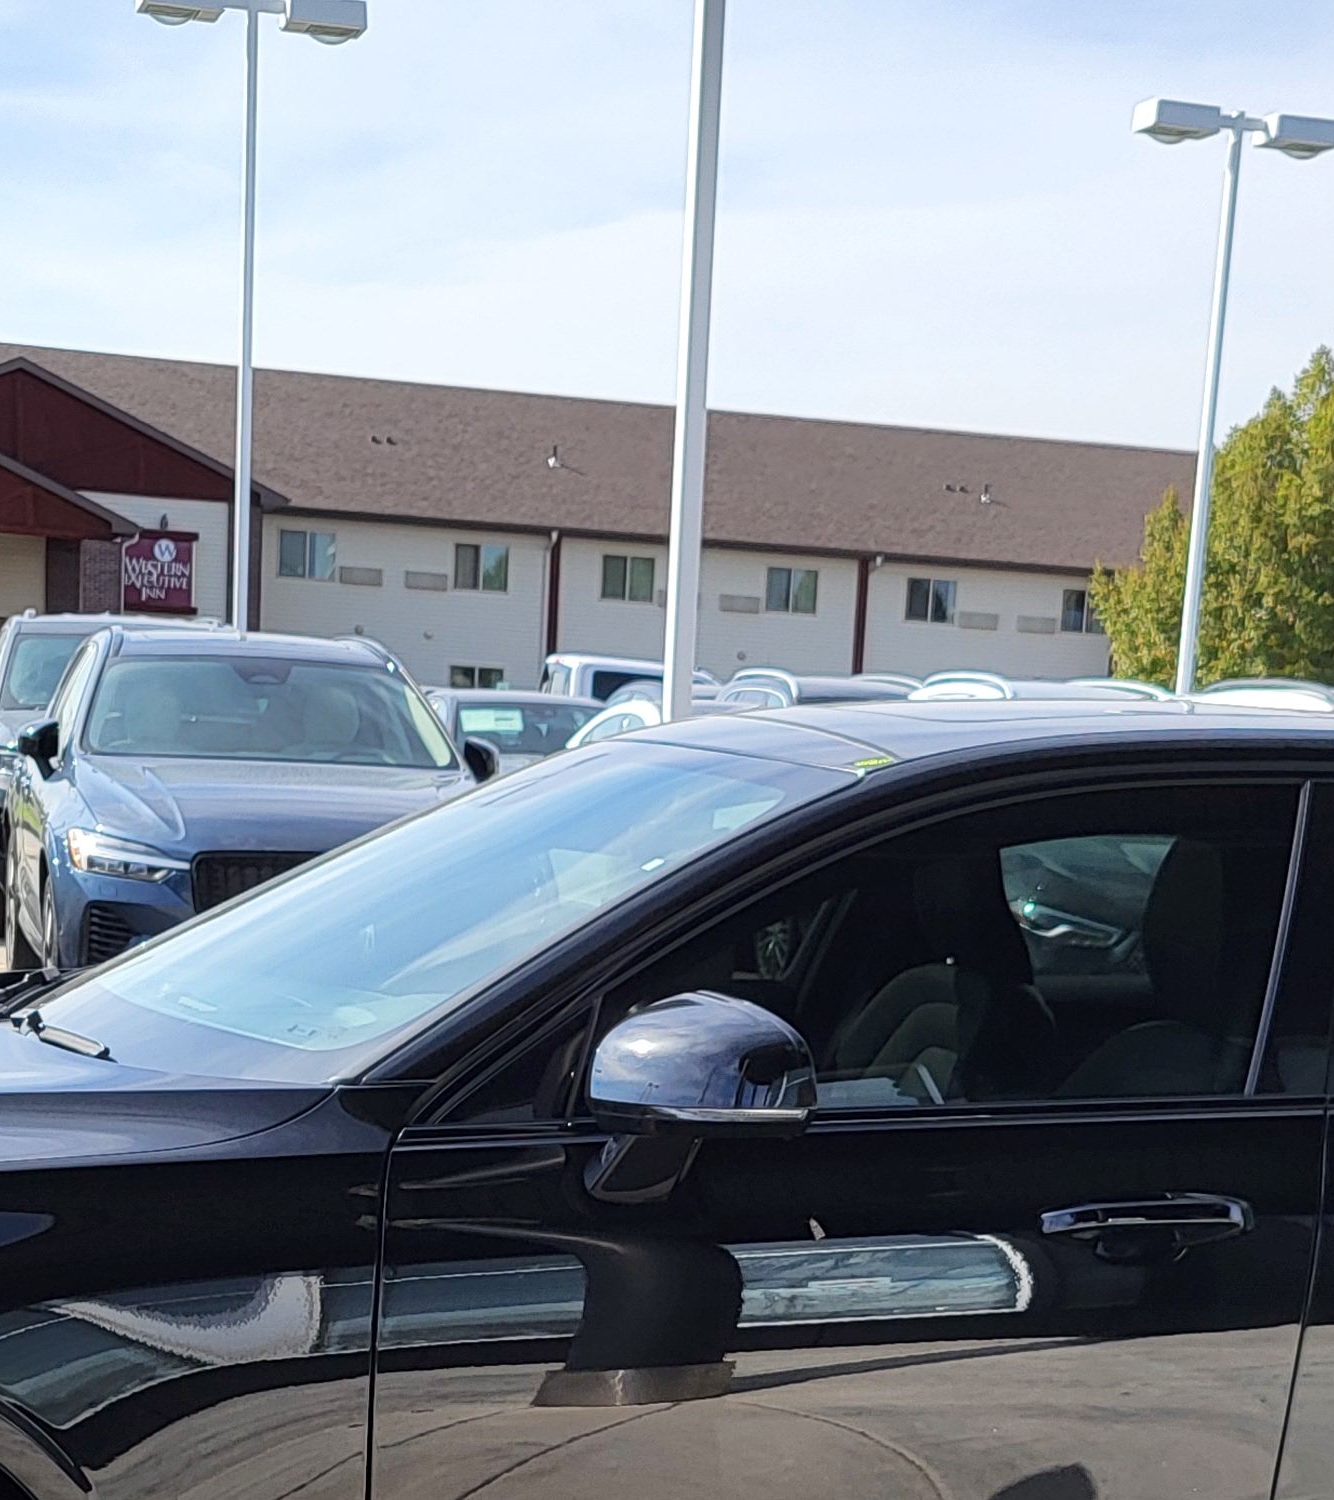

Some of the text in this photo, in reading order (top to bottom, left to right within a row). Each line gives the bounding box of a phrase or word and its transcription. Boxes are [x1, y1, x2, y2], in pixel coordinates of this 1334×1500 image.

[125, 555, 191, 577] WESTERN
[125, 573, 188, 590] EXECUTIVE
[141, 586, 166, 602] INN
